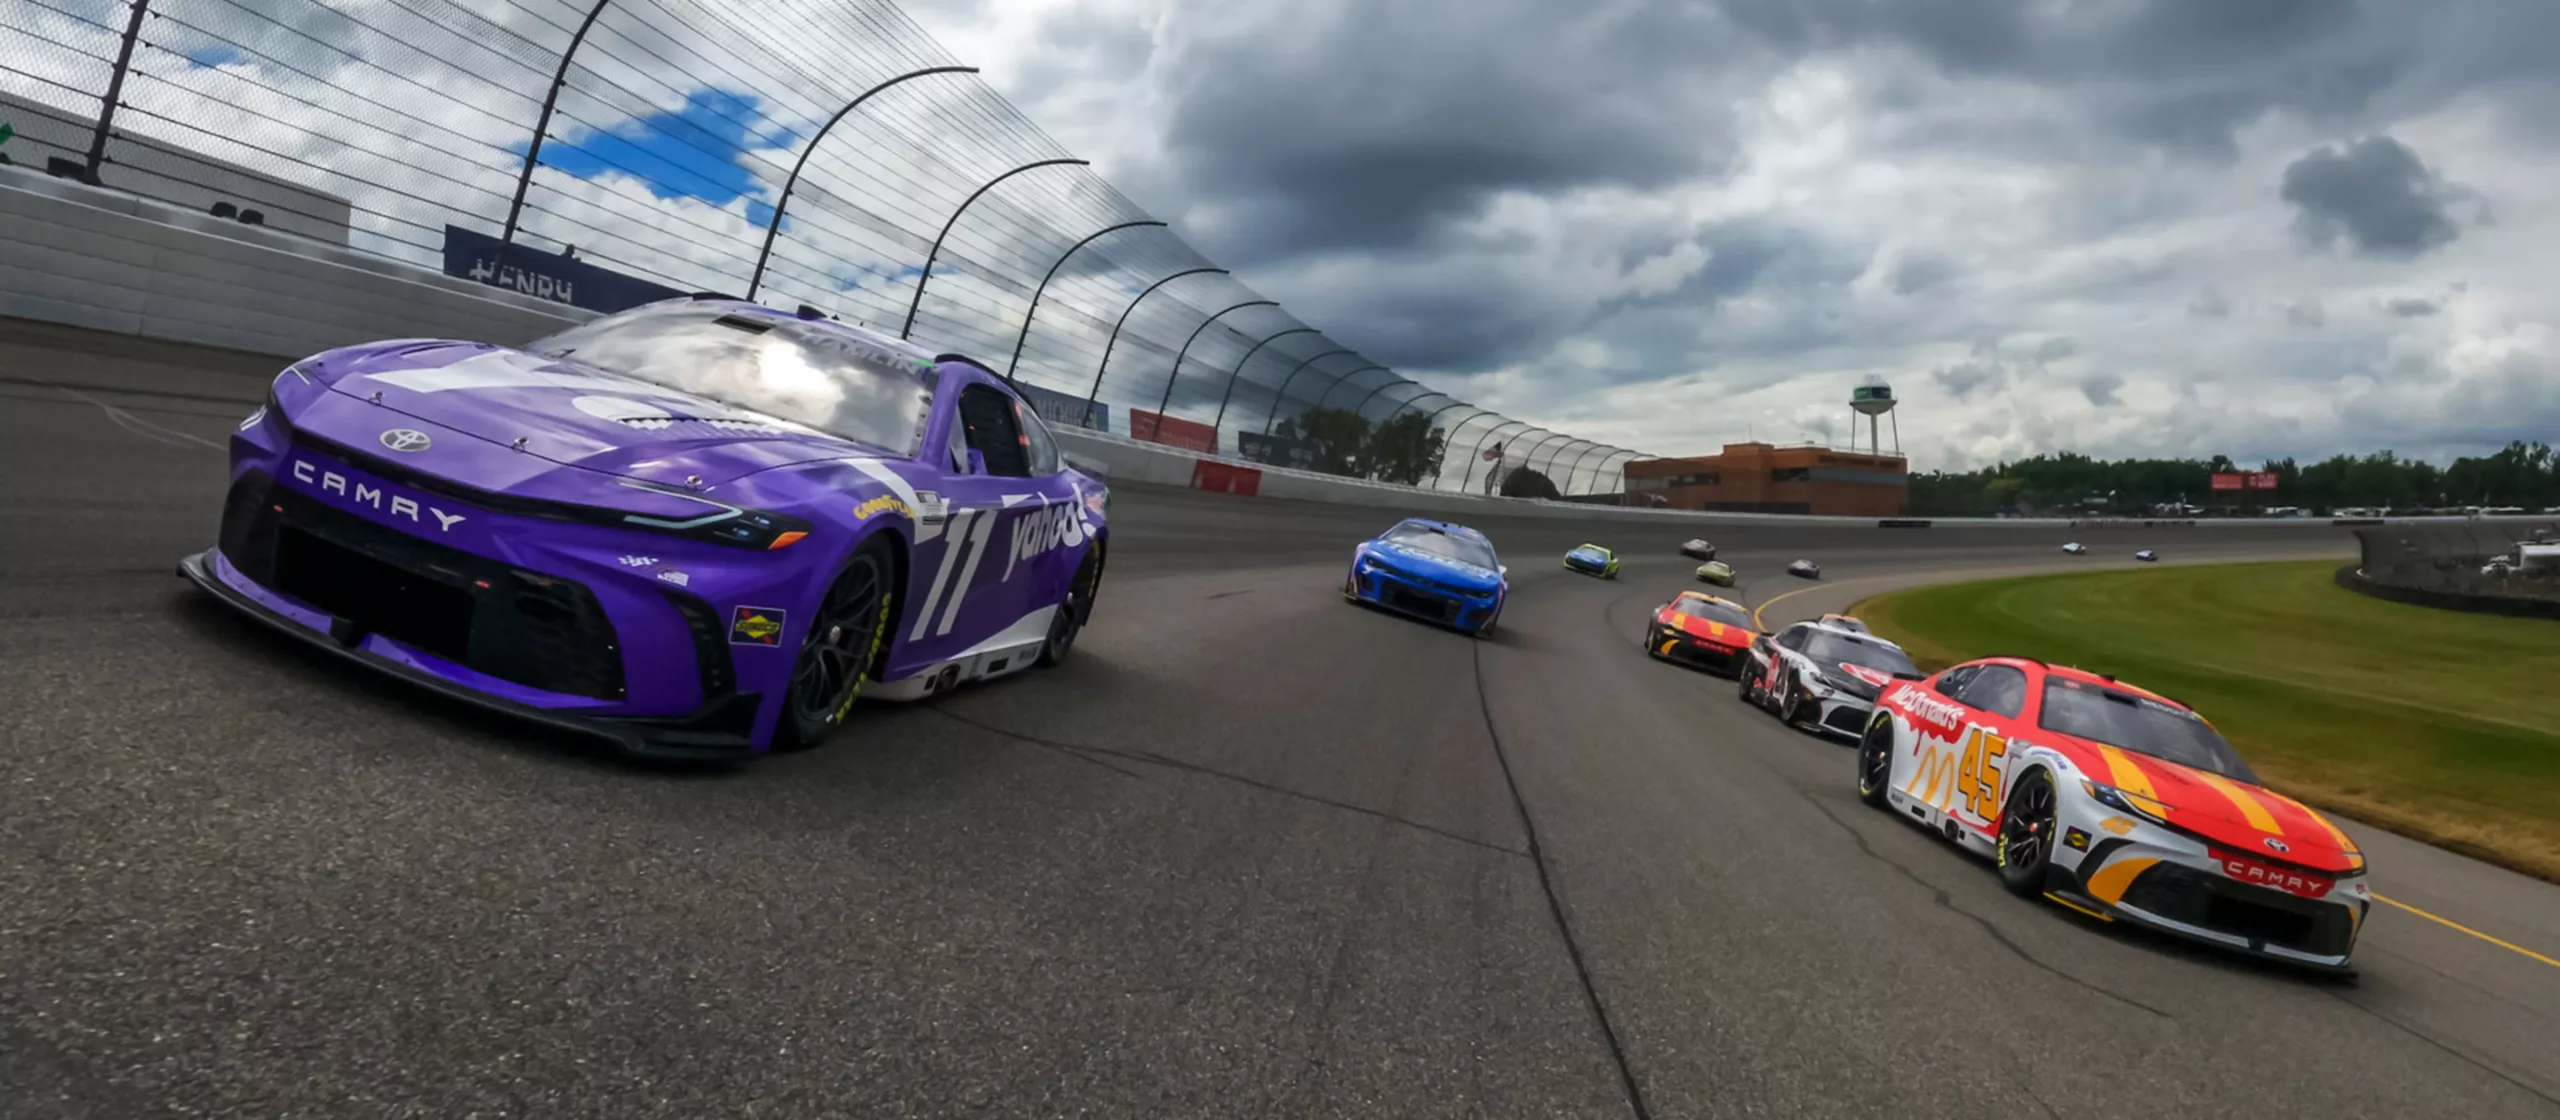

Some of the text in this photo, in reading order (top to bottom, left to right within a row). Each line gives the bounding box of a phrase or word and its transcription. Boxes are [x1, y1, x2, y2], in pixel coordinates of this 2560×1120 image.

[469, 258, 573, 302] HENRY
[294, 460, 467, 532] CAMRY
[1002, 482, 1097, 583] yahoo!
[908, 507, 1000, 642] 11
[1958, 727, 2007, 824] 45
[2228, 861, 2323, 892] CAMRY
